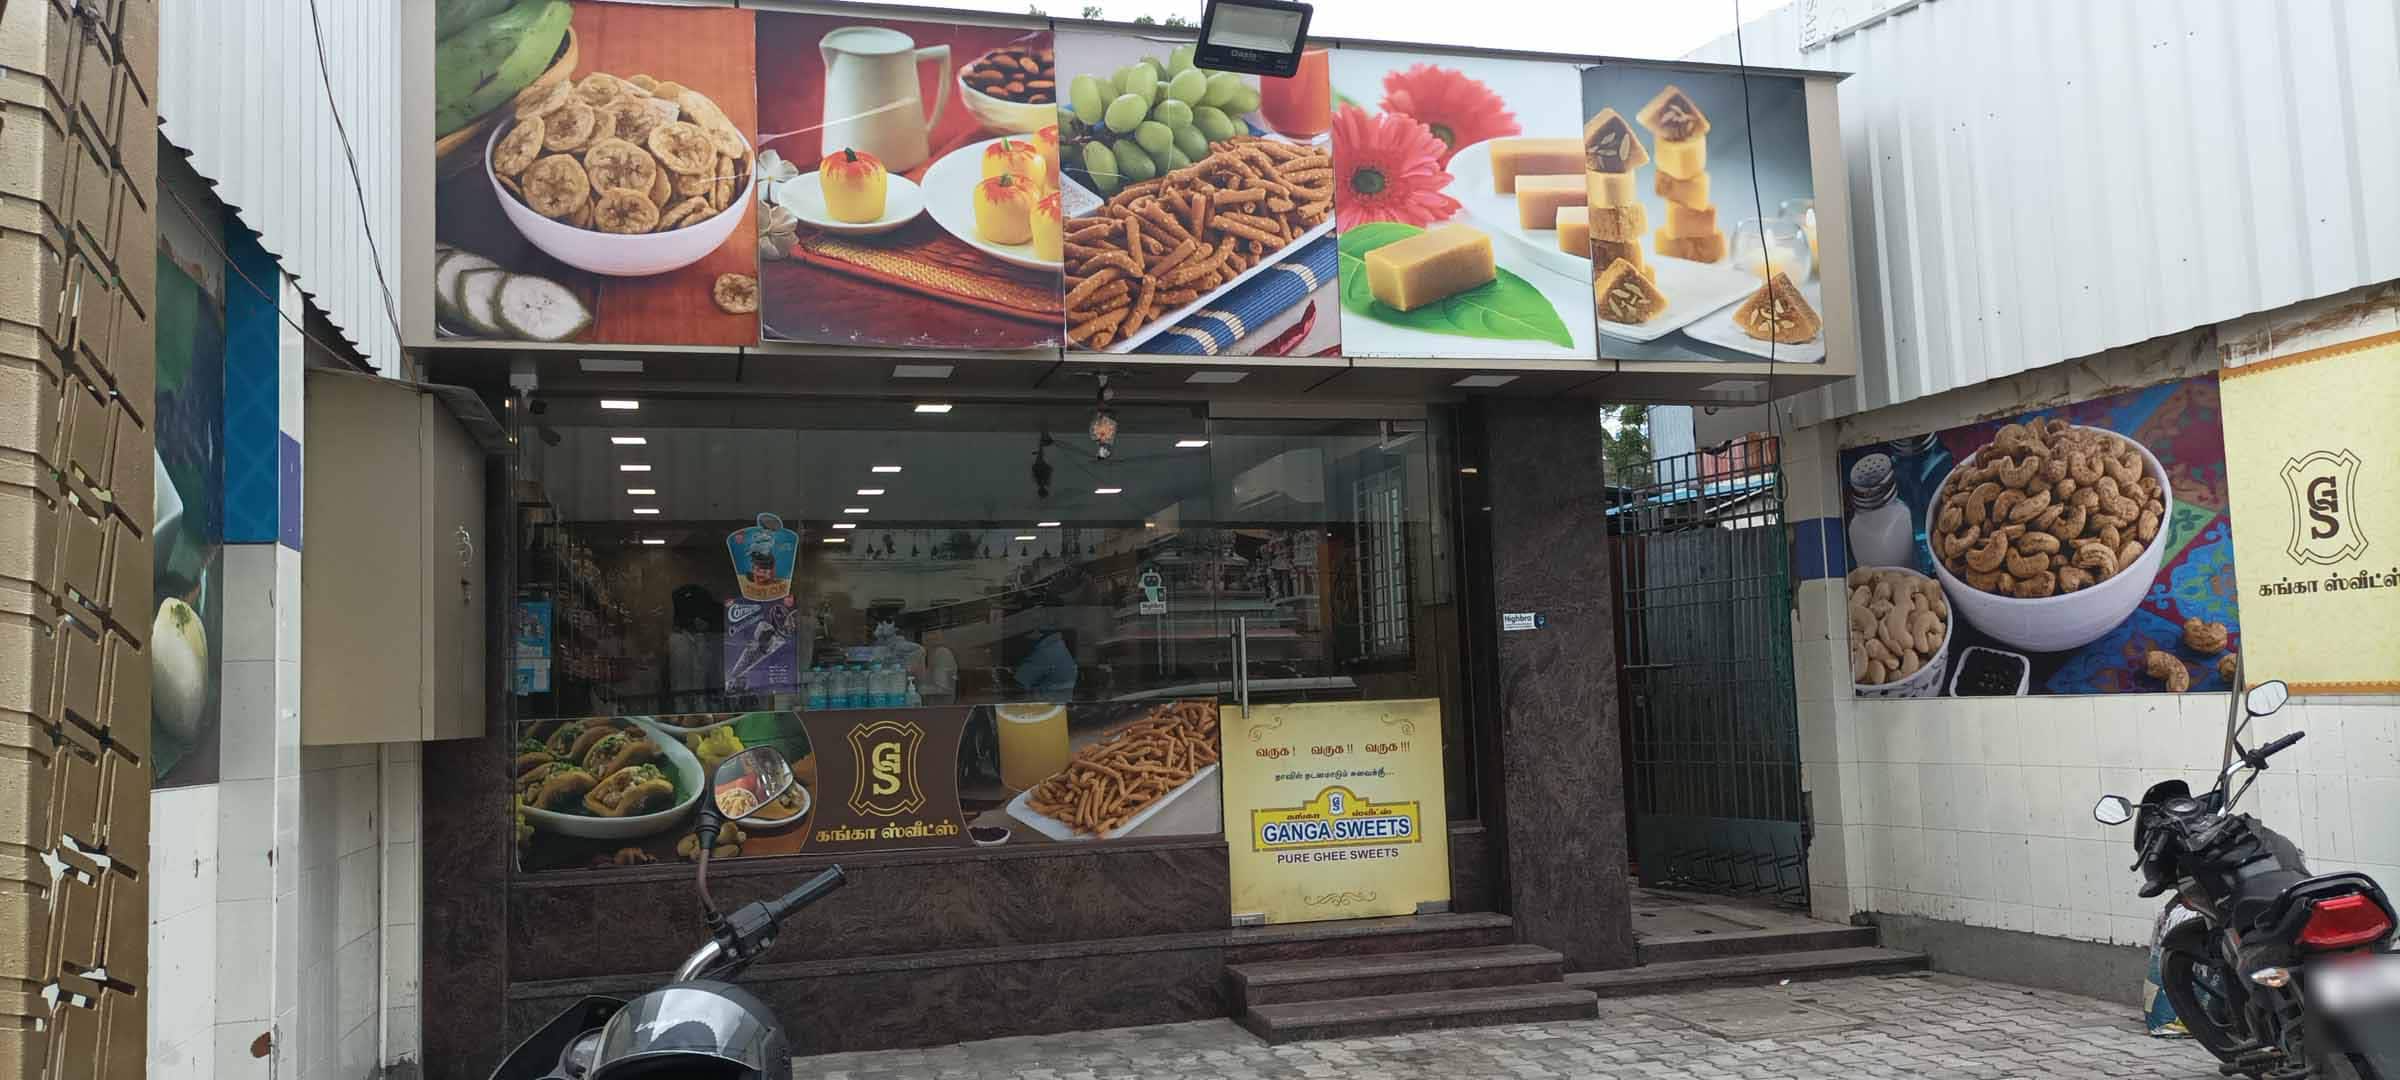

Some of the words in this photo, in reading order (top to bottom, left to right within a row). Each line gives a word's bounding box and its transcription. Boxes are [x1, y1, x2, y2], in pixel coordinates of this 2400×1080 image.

[2259, 577, 2319, 597] கங்கா
[816, 825, 877, 842] கங்கா
[881, 819, 958, 840] ஸ்வீட்ஸ்
[1264, 822, 1331, 842] GANGA
[1335, 818, 1410, 838] SWEETS
[1277, 853, 1310, 864] PURE
[1314, 850, 1346, 862] GHEE
[1350, 848, 1399, 860] SWEETS
